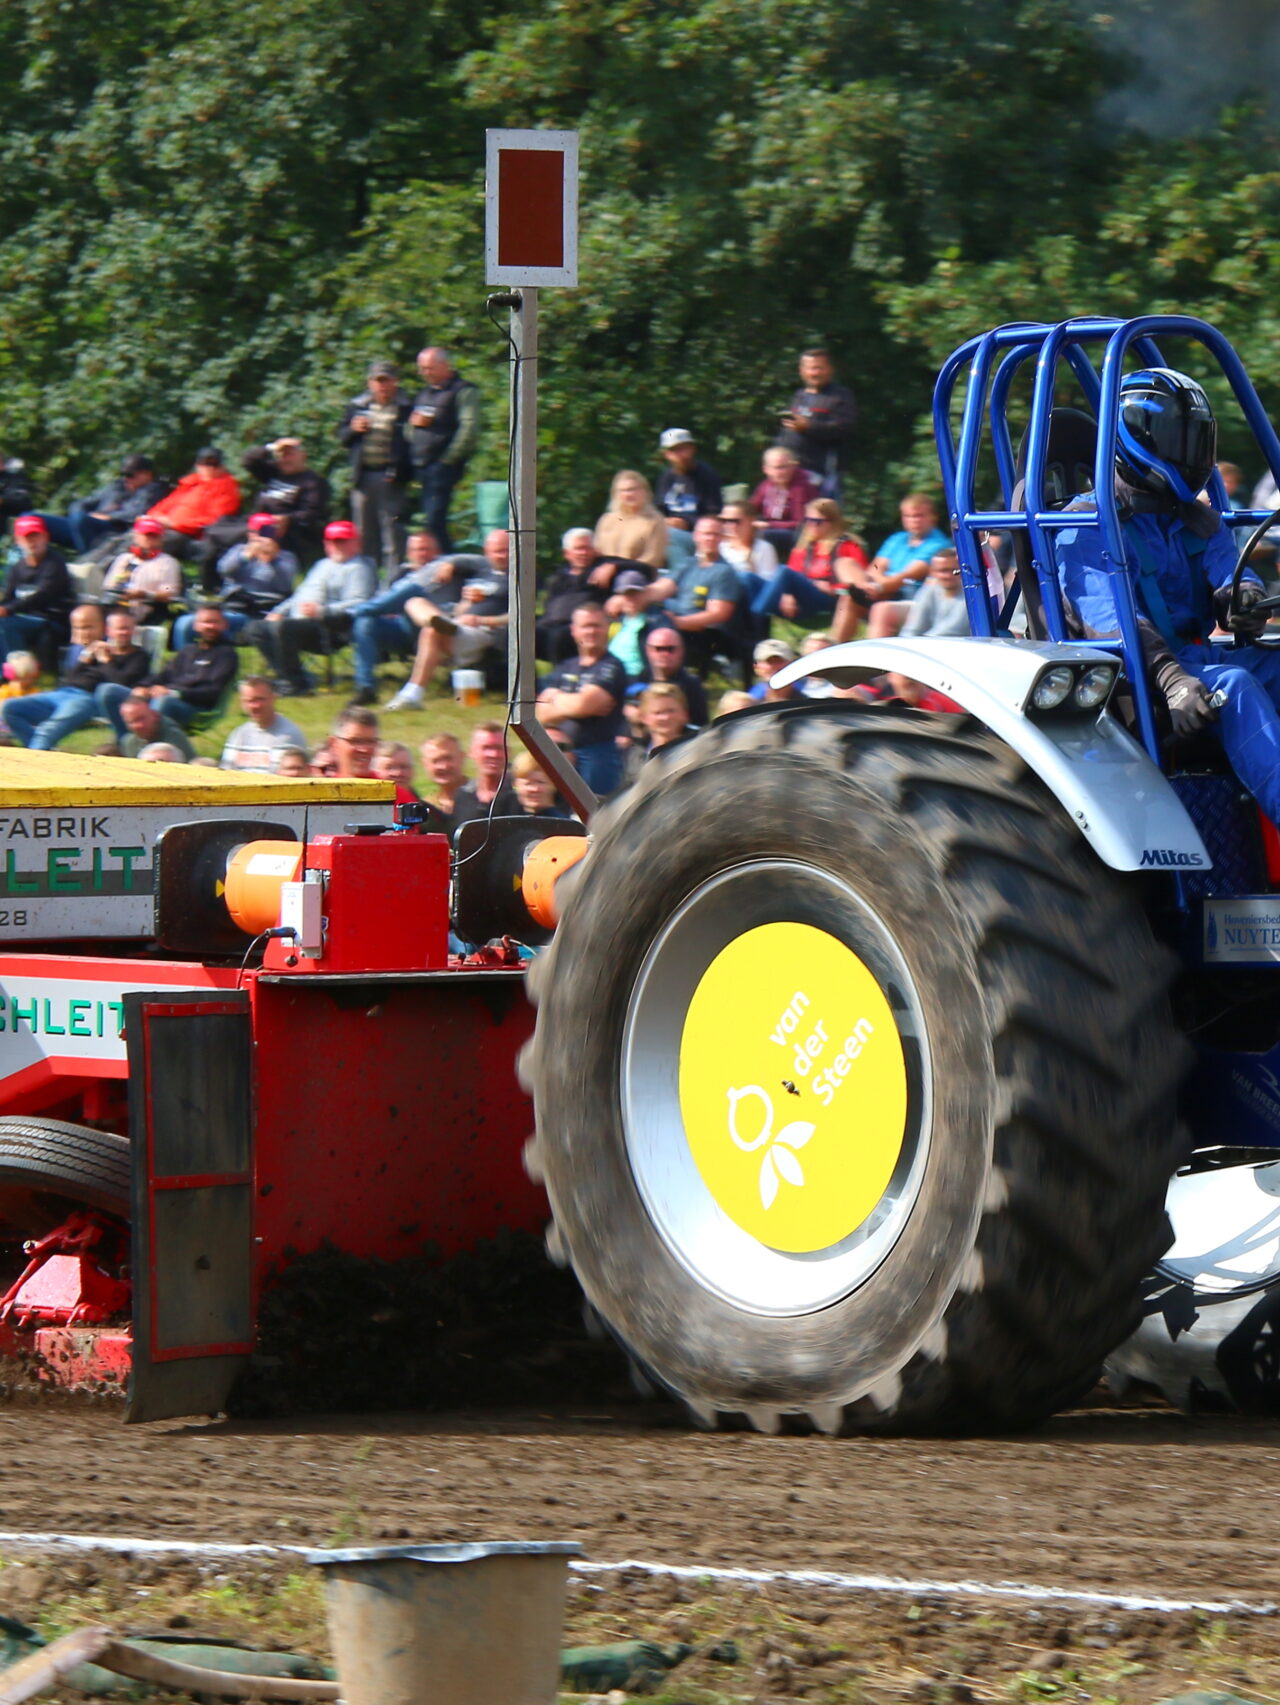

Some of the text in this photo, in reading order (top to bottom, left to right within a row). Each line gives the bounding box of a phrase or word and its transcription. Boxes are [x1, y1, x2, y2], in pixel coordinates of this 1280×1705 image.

[1140, 849, 1204, 866] Mitas
[769, 991, 811, 1047] van
[793, 1019, 830, 1077] der
[811, 1017, 874, 1106] Steen
